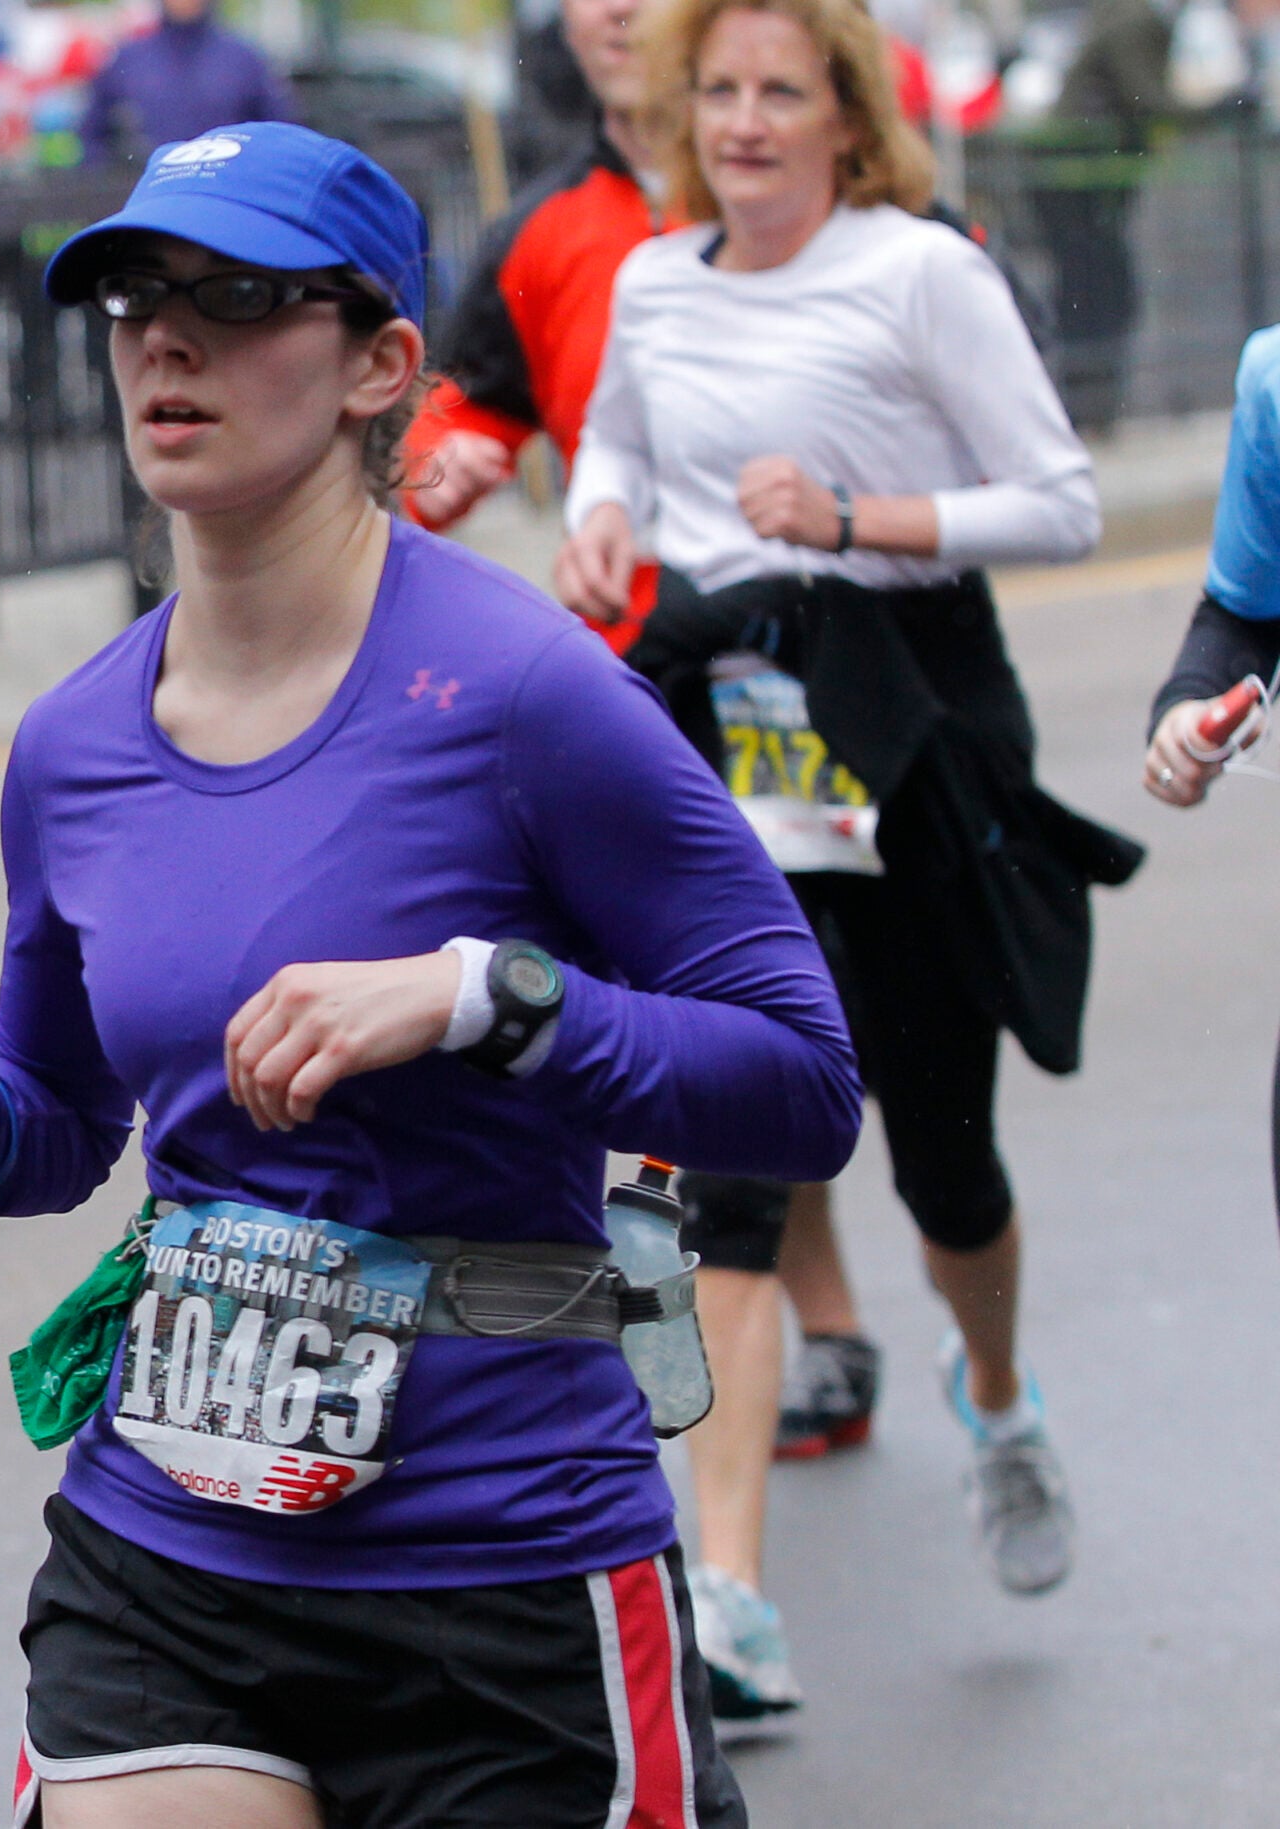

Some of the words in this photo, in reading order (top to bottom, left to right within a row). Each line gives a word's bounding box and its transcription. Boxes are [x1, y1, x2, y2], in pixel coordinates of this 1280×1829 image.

[199, 1216, 348, 1268] BOSTON'S
[190, 1252, 223, 1284] TO
[223, 1257, 416, 1326] REMEMBER
[123, 1289, 399, 1456] 10463
